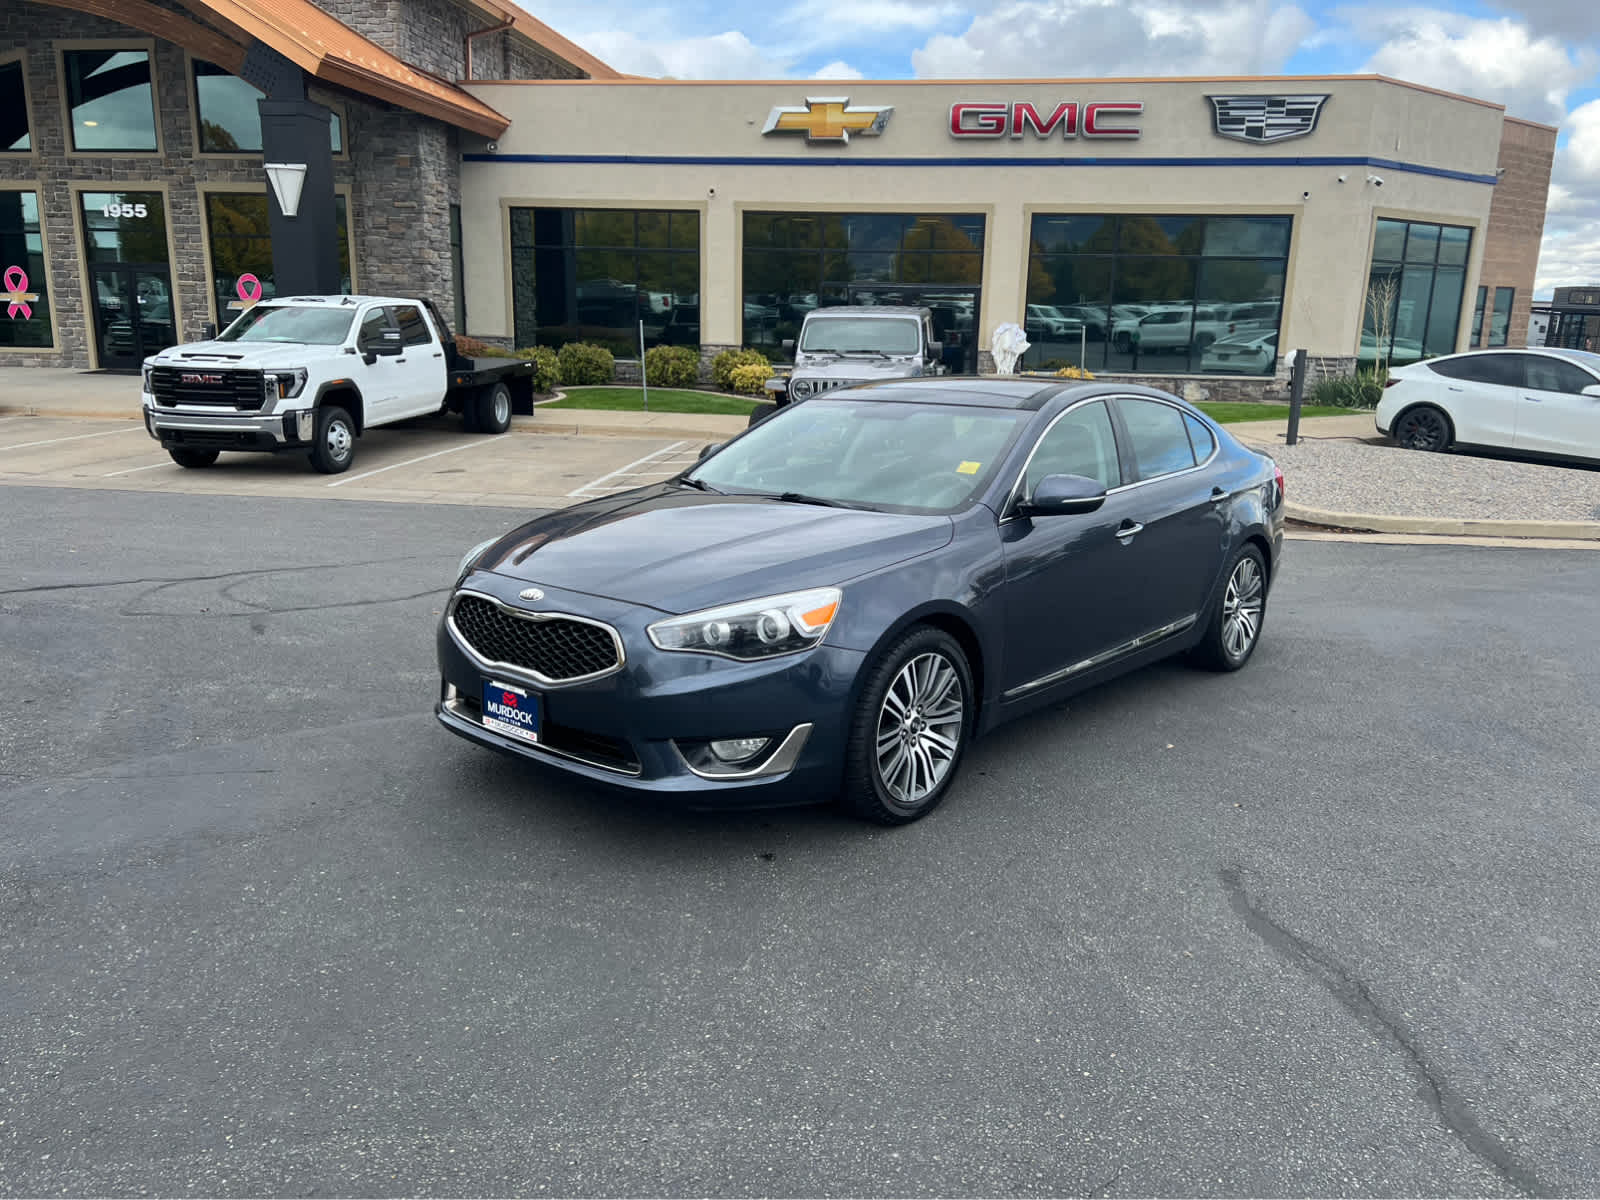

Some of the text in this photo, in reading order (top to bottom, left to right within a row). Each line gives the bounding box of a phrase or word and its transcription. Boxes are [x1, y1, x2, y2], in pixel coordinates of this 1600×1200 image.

[950, 101, 1144, 139] GMC
[103, 203, 148, 218] 1955
[181, 374, 223, 384] GMC
[487, 700, 533, 725] MURDOCK
